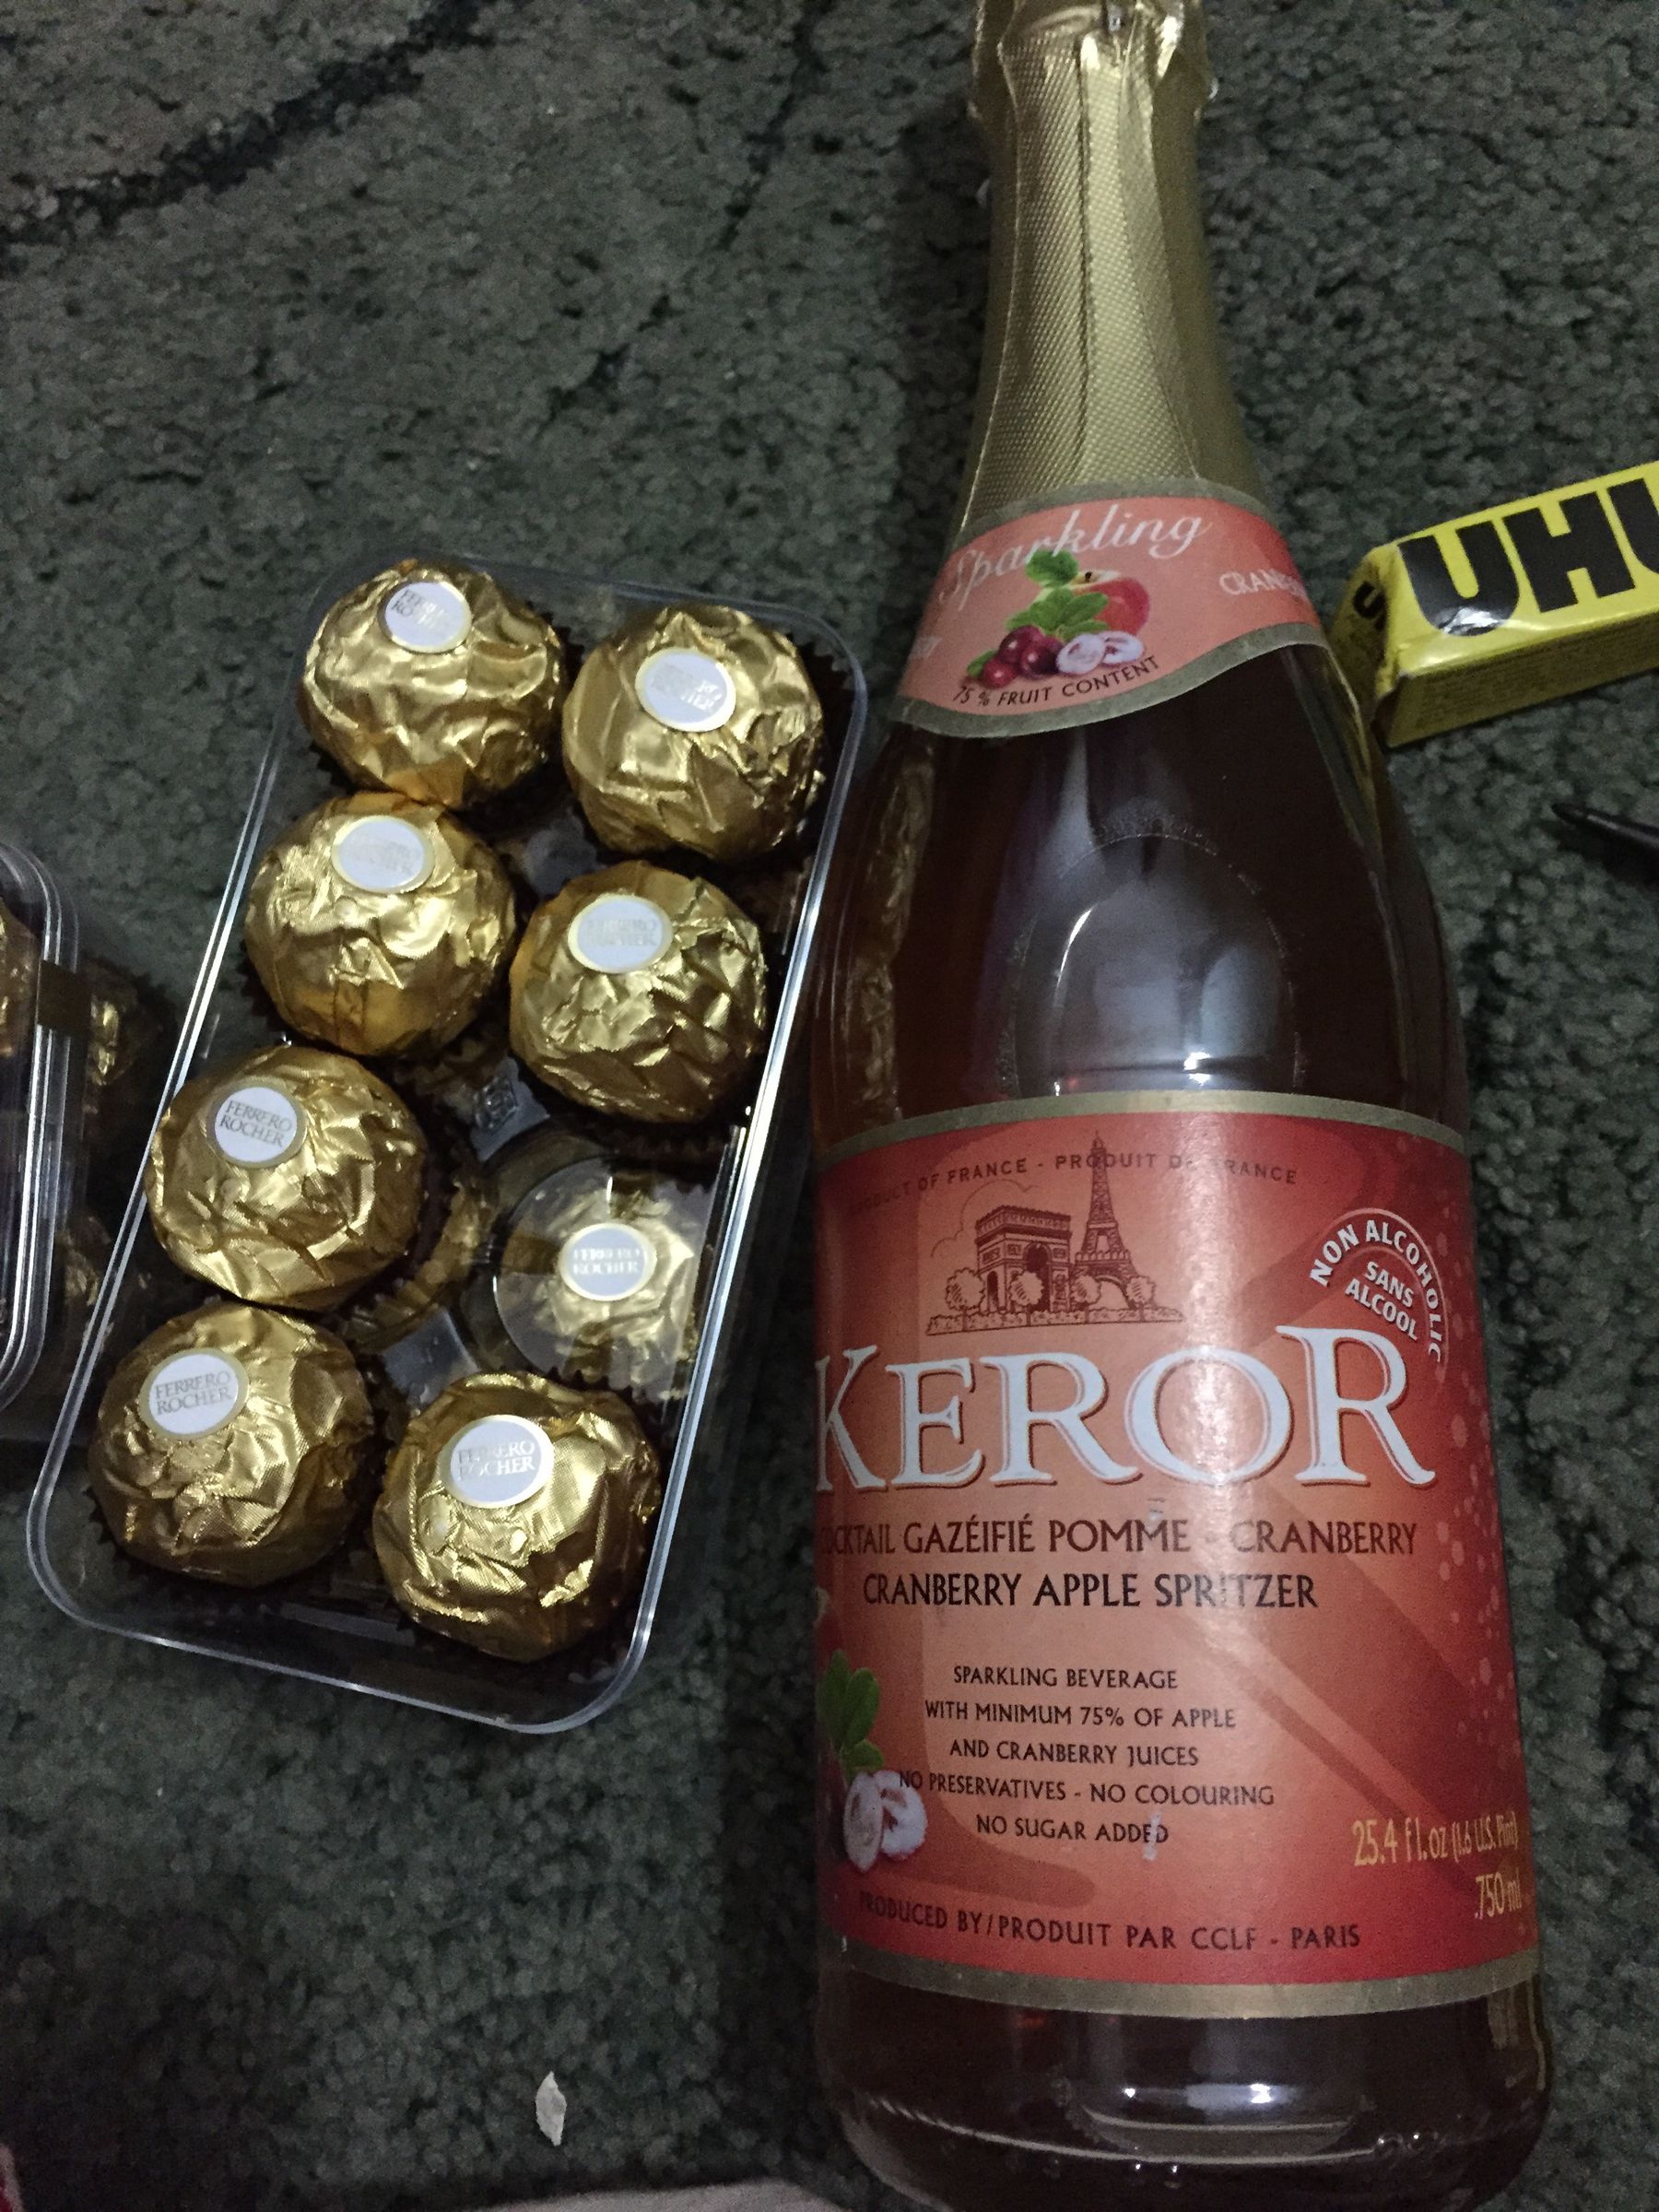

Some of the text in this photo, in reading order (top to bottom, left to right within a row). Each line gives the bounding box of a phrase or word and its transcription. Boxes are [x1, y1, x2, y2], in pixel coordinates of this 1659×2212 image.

[938, 504, 1212, 612] Sparkling
[952, 685, 974, 704] 75
[996, 686, 1052, 707] FRUIT
[1062, 655, 1160, 698] CONTENT
[219, 1113, 285, 1148] ROCHER
[225, 1100, 293, 1133] FERRERO
[917, 1172, 941, 1191] OF
[947, 1158, 1028, 1184] FRANCE
[1054, 1153, 1156, 1171] PRODUIT
[1309, 1218, 1446, 1363] NON ALCOHOLIC
[1363, 1261, 1415, 1309] SANS
[1344, 1277, 1419, 1342] ALCOOL
[156, 1370, 231, 1400] FERRERO
[156, 1385, 236, 1417] ROCHER
[816, 1324, 1437, 1494] KEROR
[903, 1513, 1035, 1555] GAZÉIFIÉ
[1049, 1519, 1192, 1553] POMME
[1229, 1519, 1418, 1556] CRANBERRY
[863, 1572, 1320, 1608] CRANBERRY APPLE SPRITZER
[953, 1665, 1179, 1689] SPARKLING BEVERAGE
[924, 1700, 1237, 1729] WITH MINIMUM 75% OF APPLE
[949, 1738, 1199, 1768] AND CRANBERRY JUICES
[899, 1770, 922, 1790] NO
[928, 1772, 1067, 1801] PRESERVATIVES
[1089, 1783, 1127, 1805] NO
[1135, 1783, 1276, 1806] COLOURING
[976, 1813, 1170, 1843] NO SUGAR ADDED
[1351, 1818, 1398, 1866] 25.4
[859, 1890, 948, 1929] PRODUCED
[1125, 1925, 1177, 1949] PAR
[1191, 1926, 1258, 1951] CCLF
[1291, 1924, 1360, 1950] PARIS
